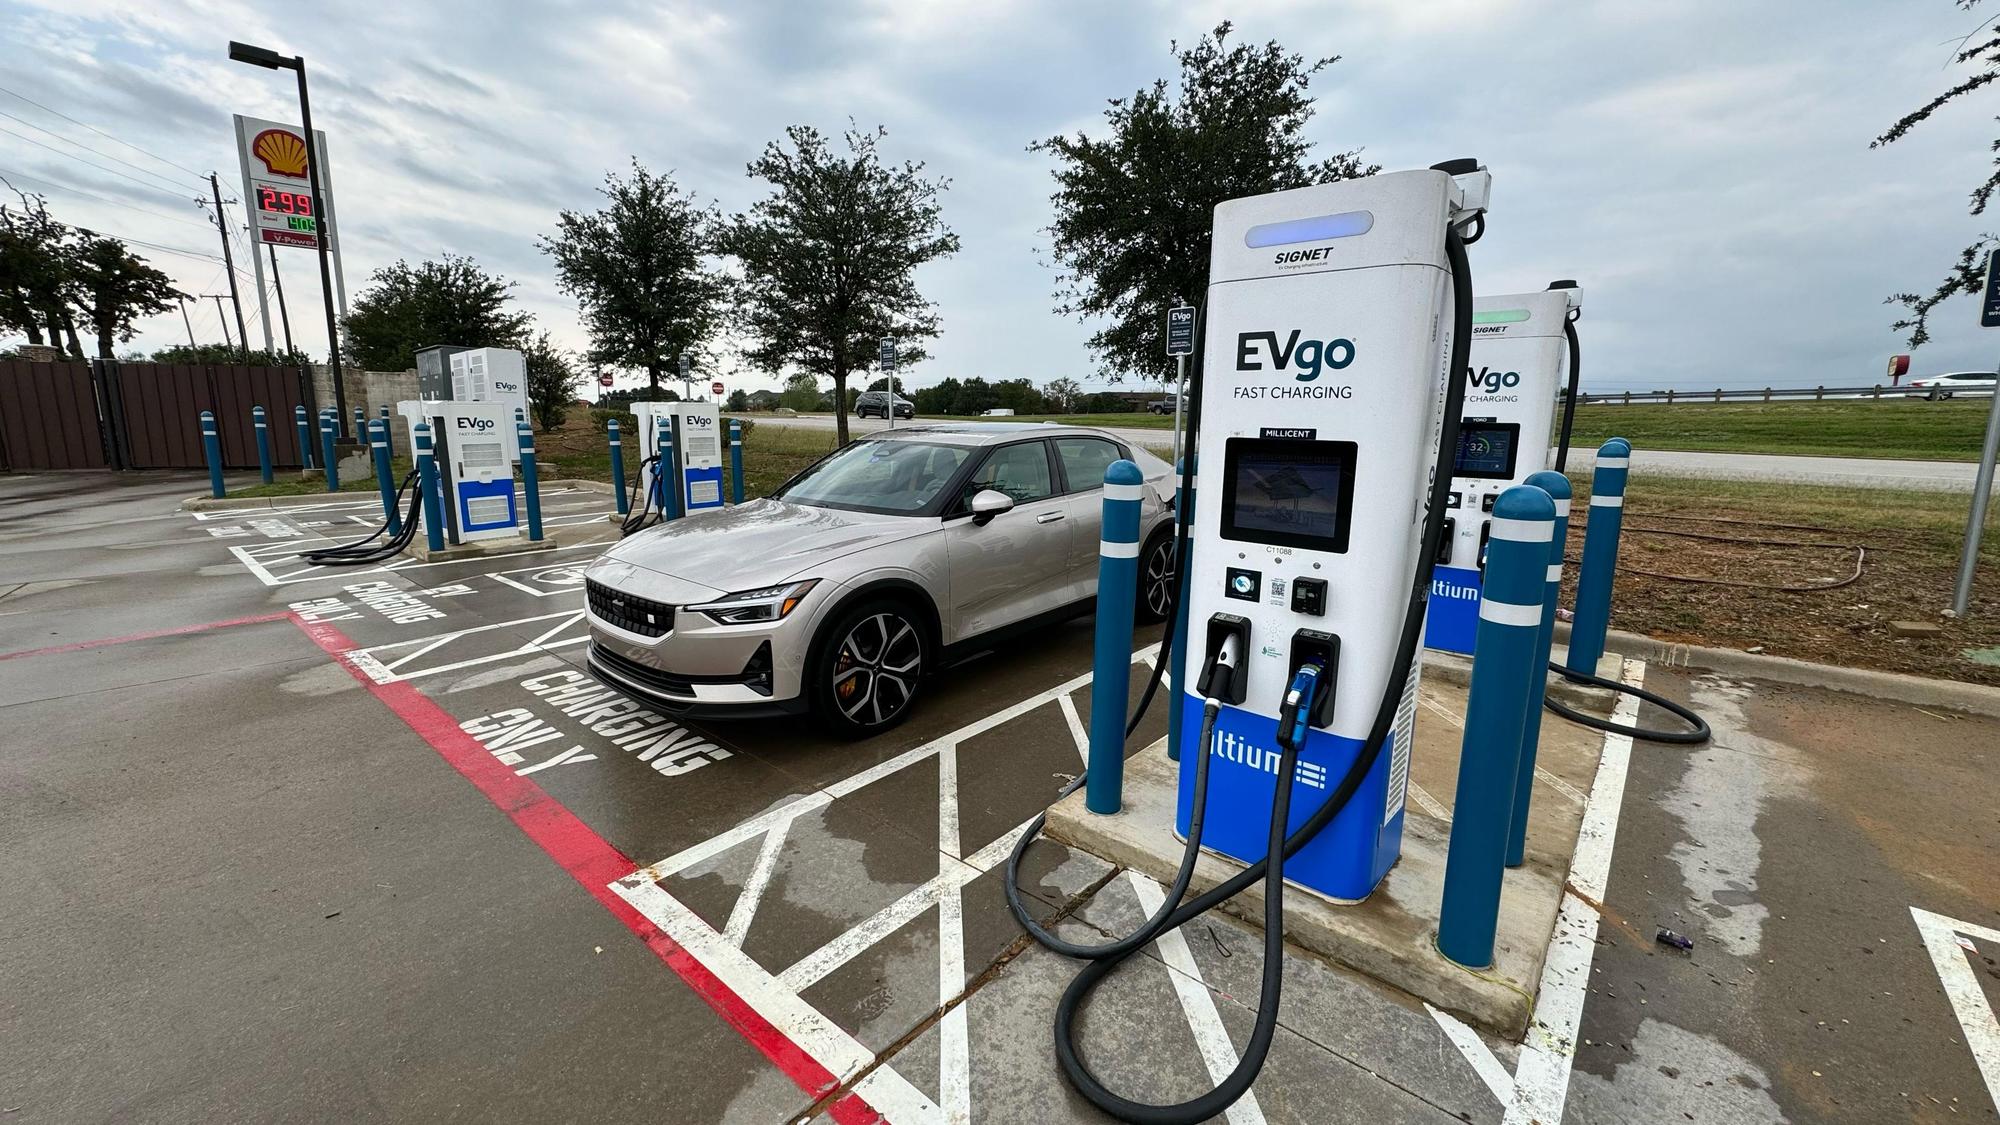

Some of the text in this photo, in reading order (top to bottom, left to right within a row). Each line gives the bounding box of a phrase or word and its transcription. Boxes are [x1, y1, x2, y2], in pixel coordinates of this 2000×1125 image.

[1274, 247, 1334, 265] SIGNET
[1172, 312, 1191, 321] EVgo
[1473, 326, 1508, 334] SIGNET
[1236, 329, 1355, 382] EVgo
[496, 382, 517, 391] EVgo
[1467, 367, 1520, 394] Vgo
[1234, 386, 1352, 399] FAST CHARGING
[1470, 395, 1518, 403] CHARGING
[457, 417, 494, 431] EVgo
[687, 415, 712, 427] EVgo
[1266, 430, 1311, 438] MILLICENT
[1469, 442, 1484, 452] 32
[1432, 579, 1479, 601] ltium
[288, 597, 365, 625] ONLY
[520, 670, 734, 777] CHARGING
[458, 708, 599, 777] ONLY
